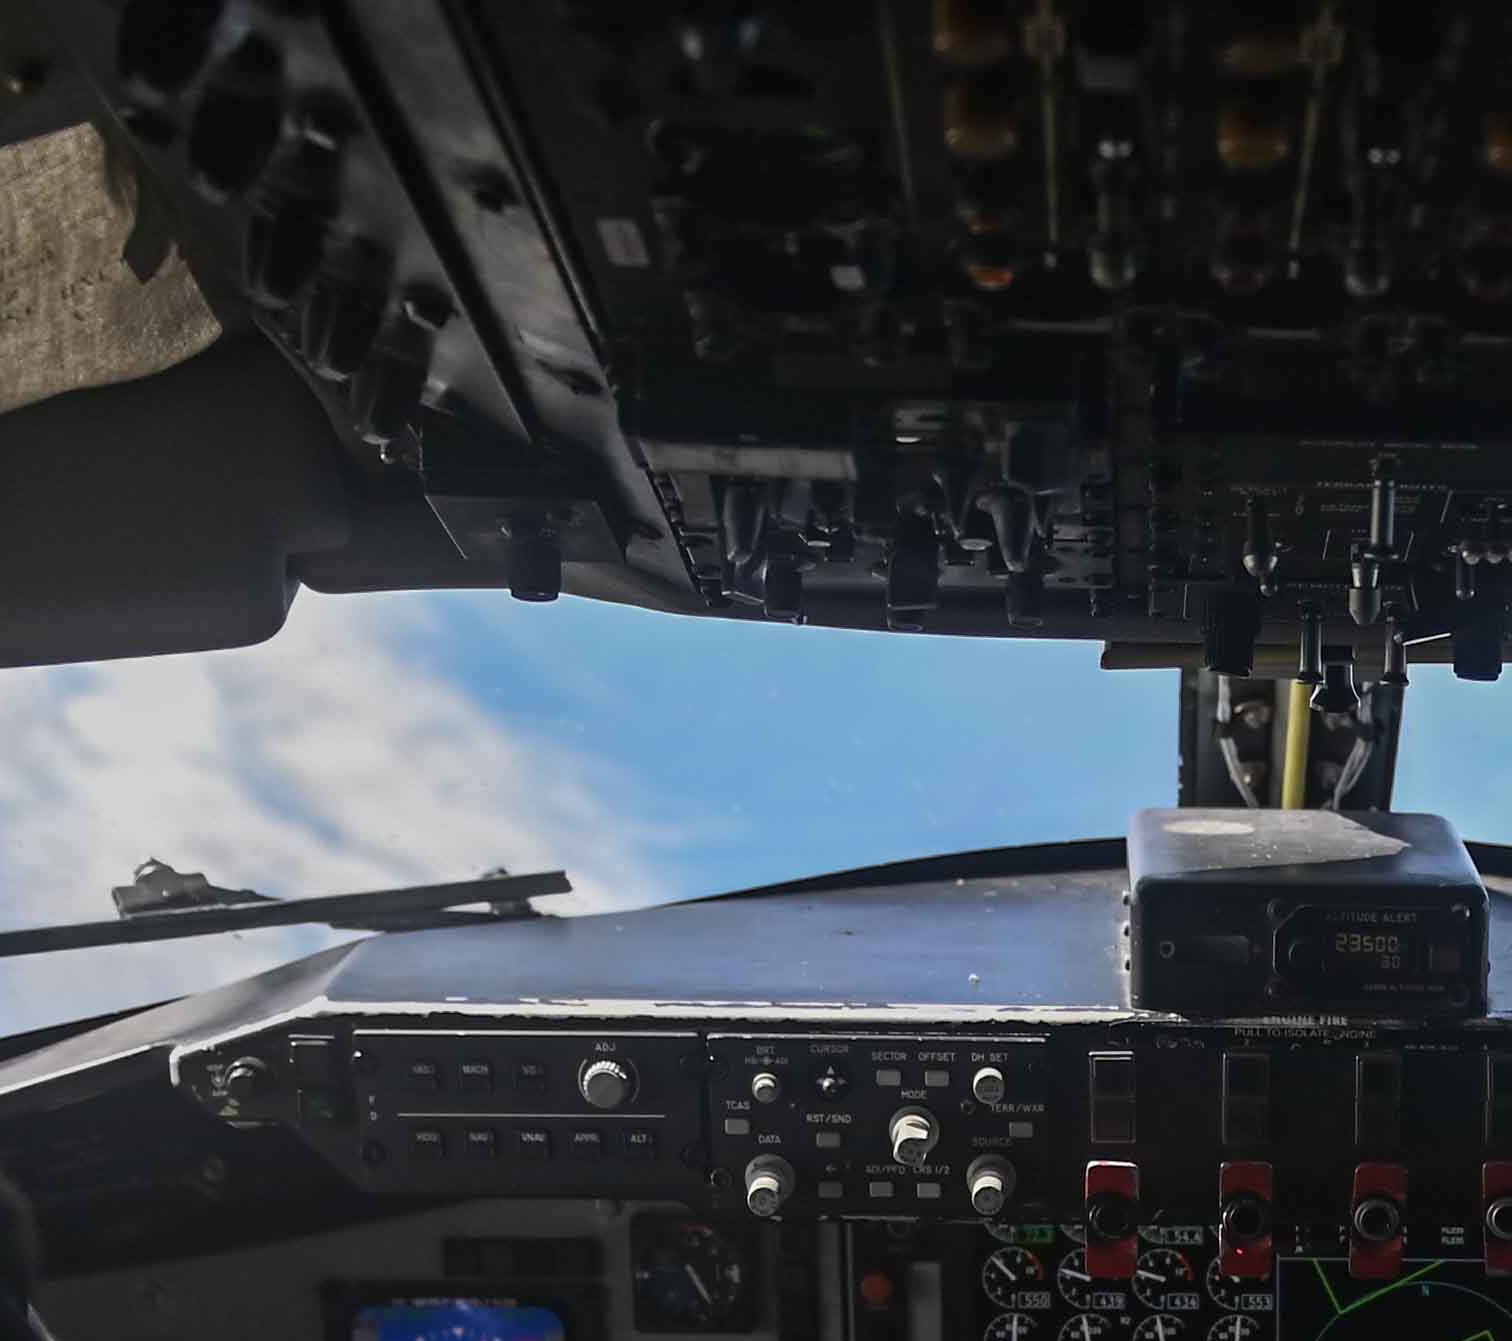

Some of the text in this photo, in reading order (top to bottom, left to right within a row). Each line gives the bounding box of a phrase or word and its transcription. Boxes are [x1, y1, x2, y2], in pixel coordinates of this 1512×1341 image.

[871, 1051, 907, 1062] SECTOR
[918, 1051, 956, 1063] OFFSET
[900, 1090, 929, 1102] MODE
[725, 1100, 751, 1111] TCAS
[758, 1133, 782, 1145] DATA
